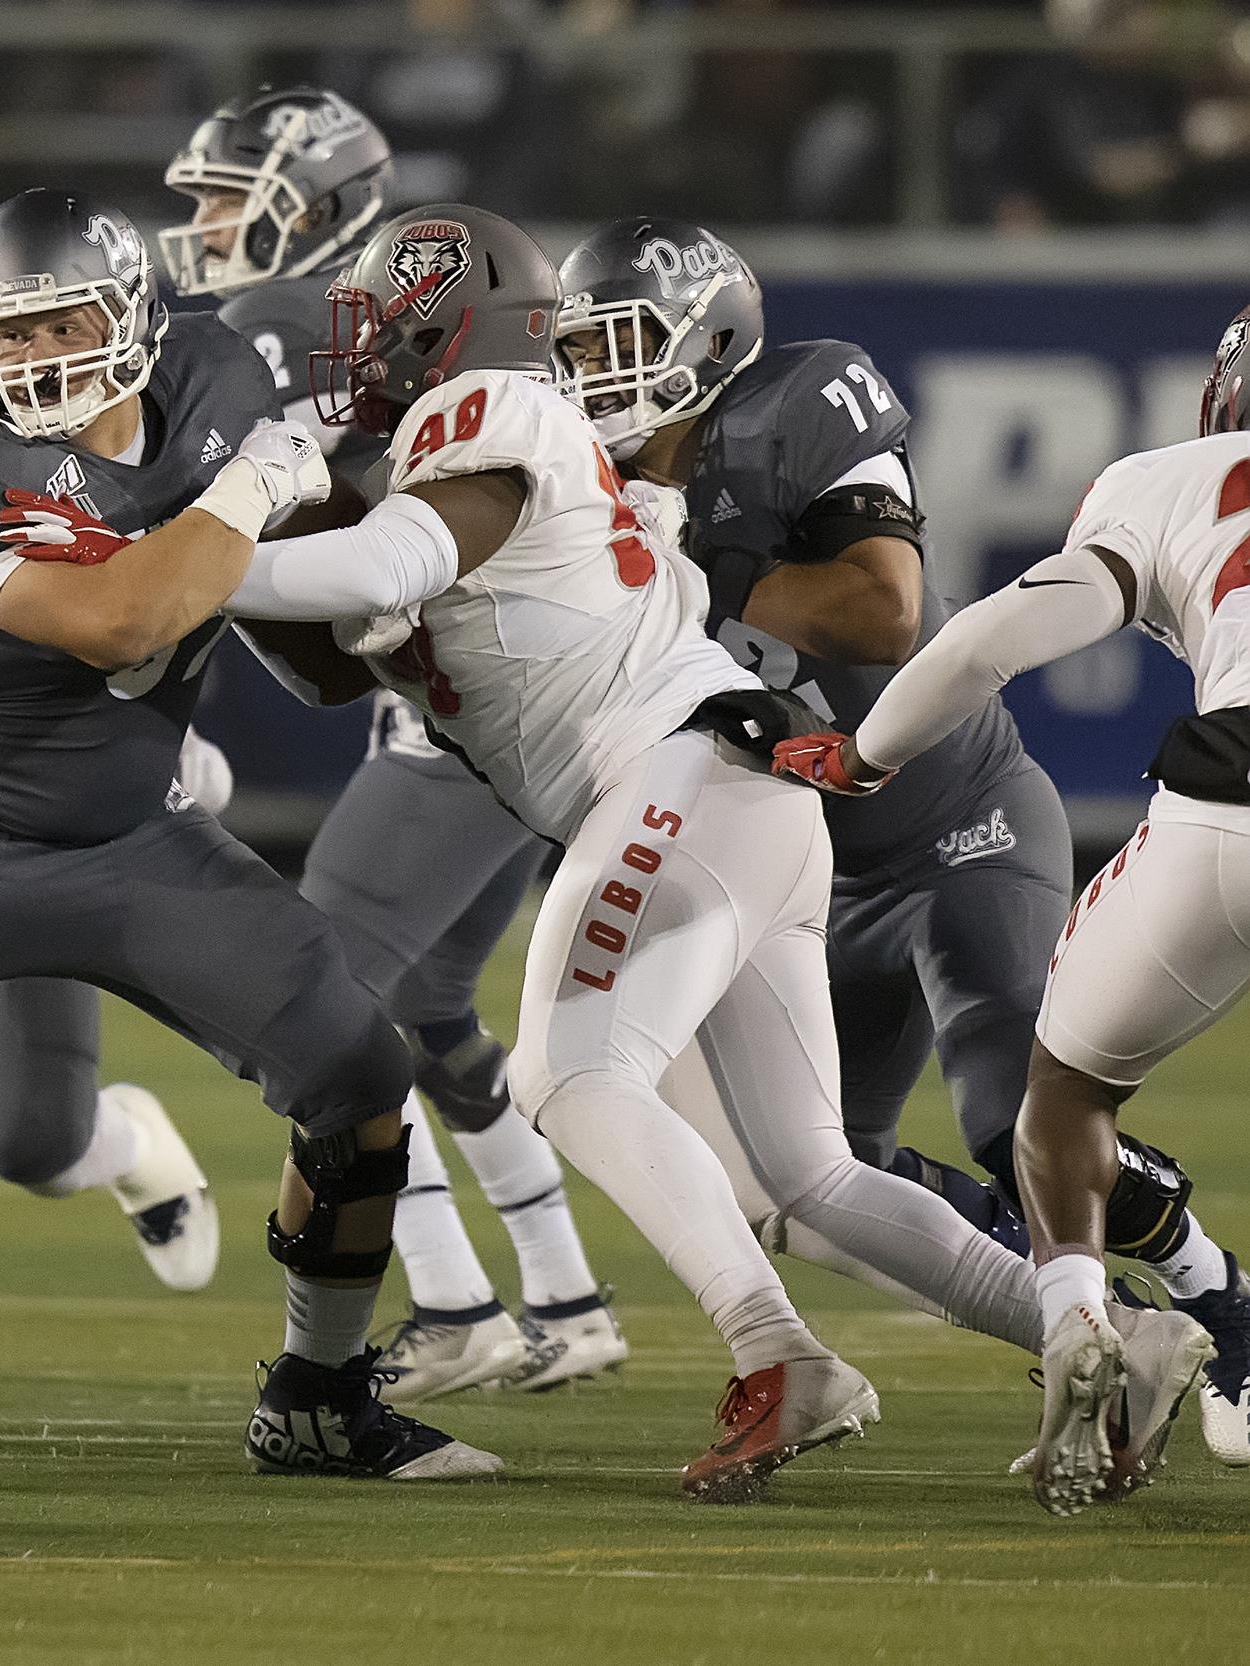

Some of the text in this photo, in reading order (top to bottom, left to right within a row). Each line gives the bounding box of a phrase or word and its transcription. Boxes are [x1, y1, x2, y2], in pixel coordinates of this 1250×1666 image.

[399, 224, 464, 241] LOBOS
[1, 279, 38, 292] EVADA
[820, 363, 892, 434] 72
[200, 444, 232, 464] adidas
[573, 804, 683, 993] LOBOS
